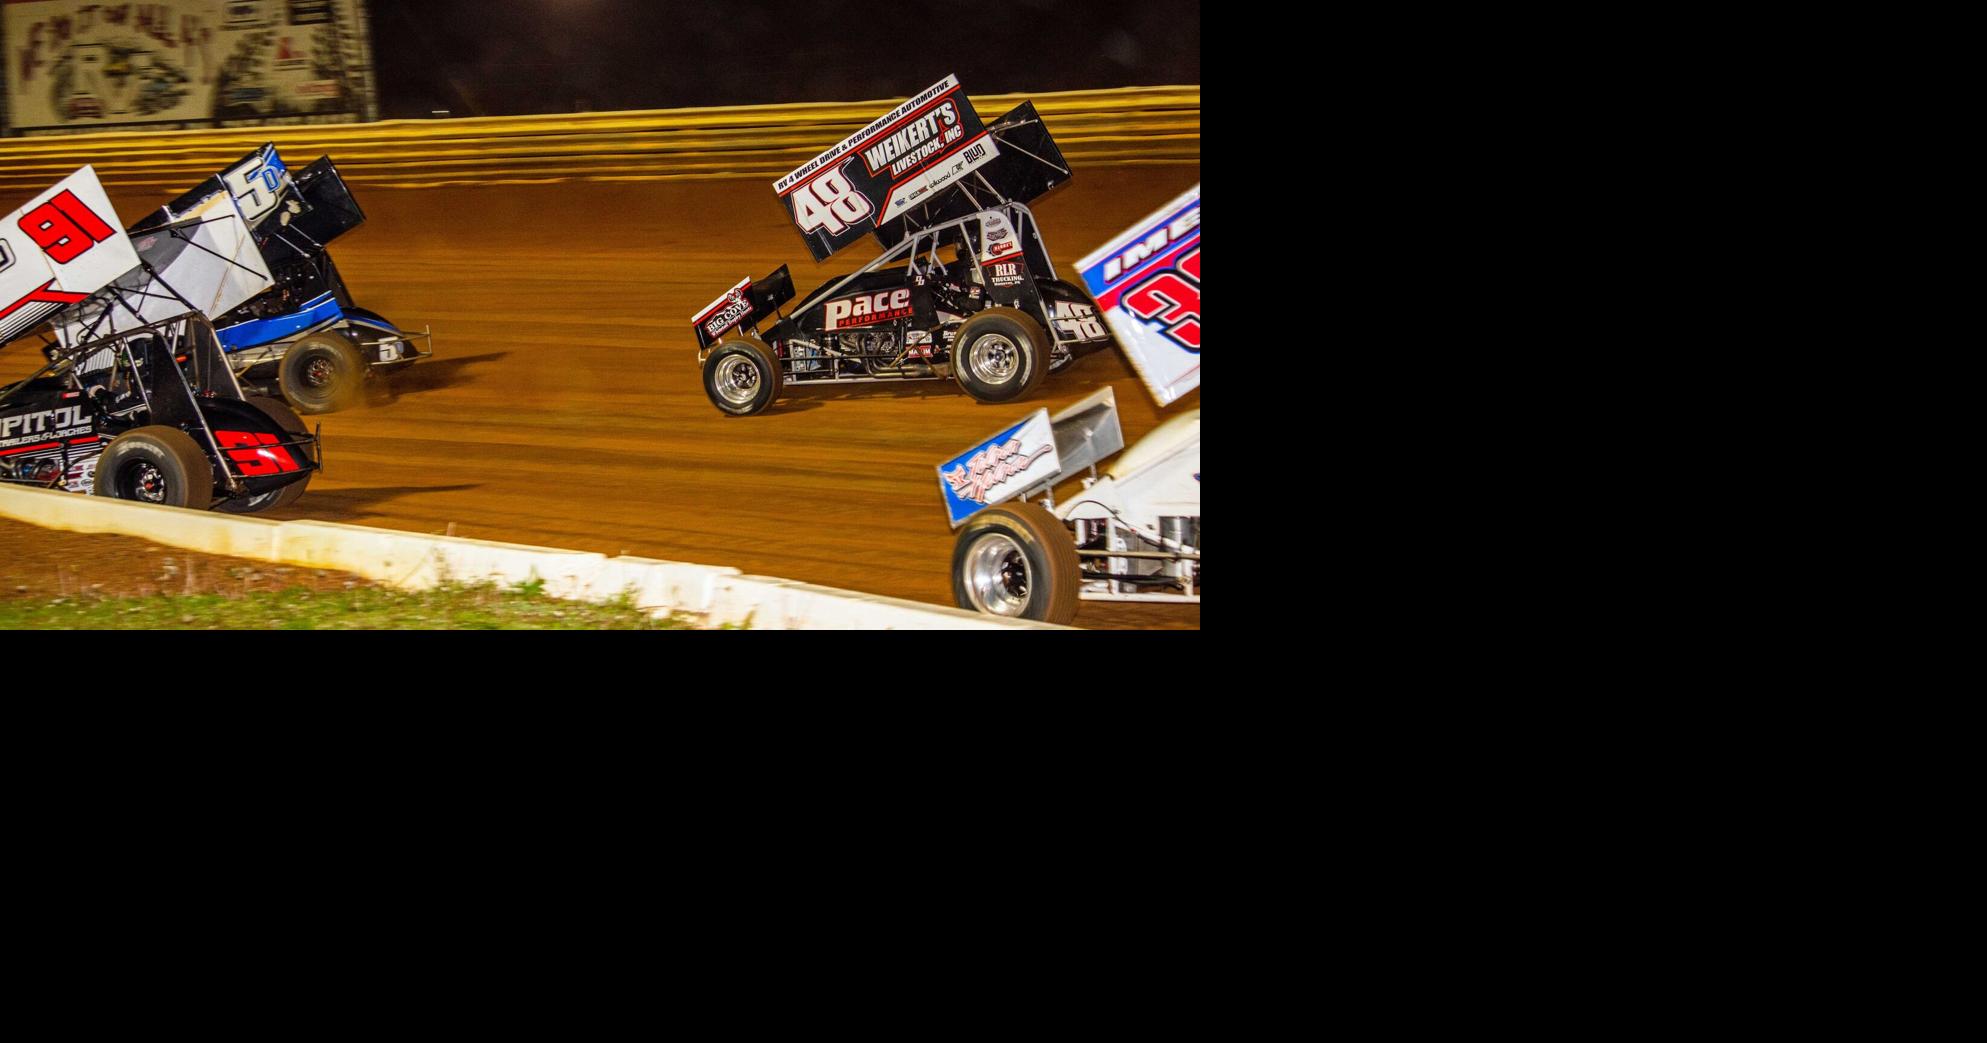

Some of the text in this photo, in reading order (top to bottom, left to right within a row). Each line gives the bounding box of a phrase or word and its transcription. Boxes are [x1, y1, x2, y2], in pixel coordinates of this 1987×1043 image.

[778, 80, 950, 190] RV 4 WHEEL DRIVE & PERFORMANCE AUTOMOTIVE
[864, 102, 956, 171] WEIKERT'S
[944, 124, 961, 143] INC
[18, 188, 117, 264] 91
[995, 263, 1016, 276] RLR
[708, 317, 724, 332] BIG
[724, 299, 749, 320] COVE
[825, 288, 910, 331] Pace
[839, 306, 913, 326] PERFORMANCE
[0, 405, 92, 438] PITOL
